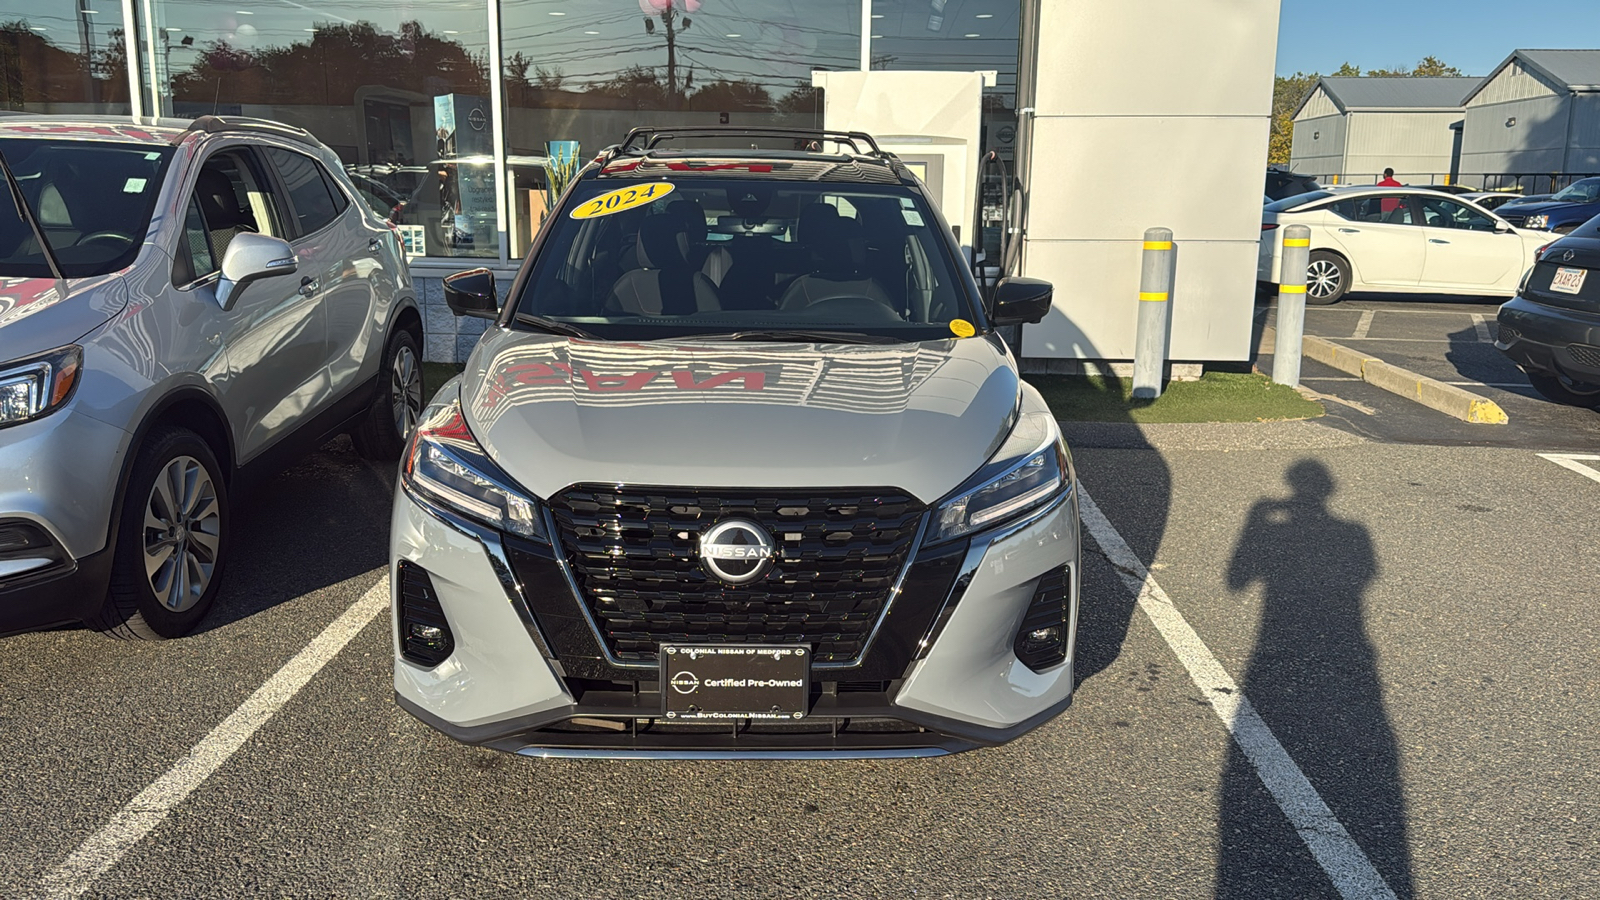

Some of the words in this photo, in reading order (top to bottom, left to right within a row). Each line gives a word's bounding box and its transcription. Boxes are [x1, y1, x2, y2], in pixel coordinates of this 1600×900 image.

[589, 185, 655, 215] 2024
[703, 546, 771, 557] NISSAN
[704, 679, 746, 687] Certified
[747, 679, 803, 687] Pre-Owned
